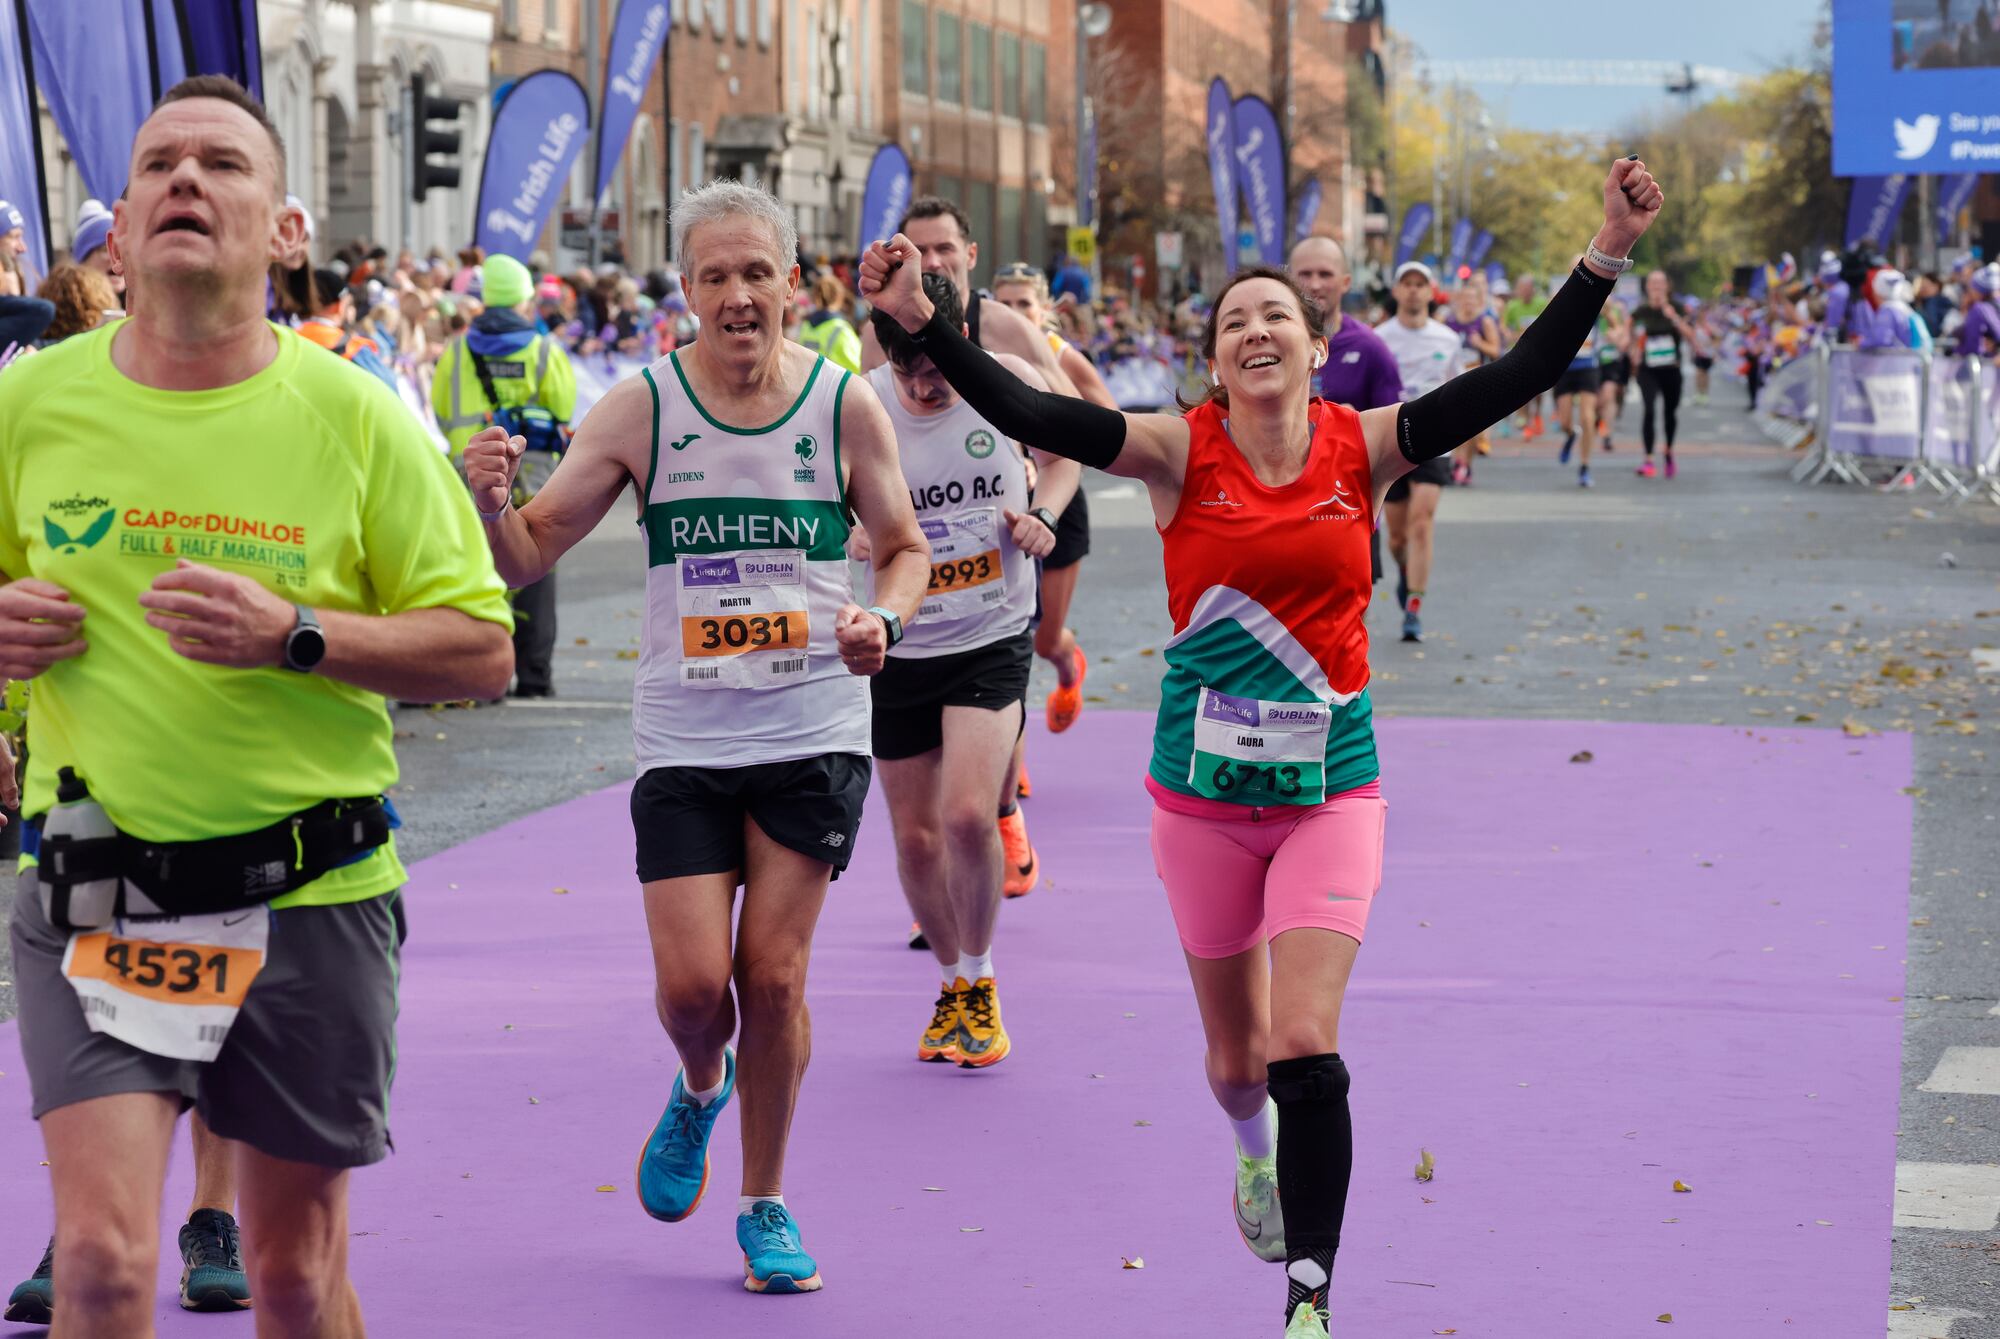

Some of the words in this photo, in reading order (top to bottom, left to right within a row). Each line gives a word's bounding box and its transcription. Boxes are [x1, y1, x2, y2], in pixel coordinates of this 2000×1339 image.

[513, 159, 556, 215] Irish
[538, 113, 580, 163] Life
[668, 471, 704, 483] LEYDENS
[909, 481, 964, 511] LIGO
[123, 509, 177, 529] GAP
[178, 516, 202, 530] OF
[205, 514, 305, 545] DUNLOE
[670, 514, 820, 548] RAHENY
[120, 533, 158, 554] FULL
[162, 536, 176, 554] &
[180, 538, 217, 558] HALF
[222, 541, 306, 569] MARATHON
[699, 568, 716, 576] Irish
[717, 567, 731, 576] Life
[745, 563, 793, 574] DUBLIN
[720, 597, 751, 608] MARTIN
[701, 616, 789, 649] 3031
[1222, 702, 1236, 714] Irish
[1236, 708, 1252, 718] Life
[1269, 709, 1319, 720] DUBLIN
[1237, 735, 1264, 748] LAURA
[1212, 760, 1303, 798] 6713
[104, 943, 229, 994] 4531
